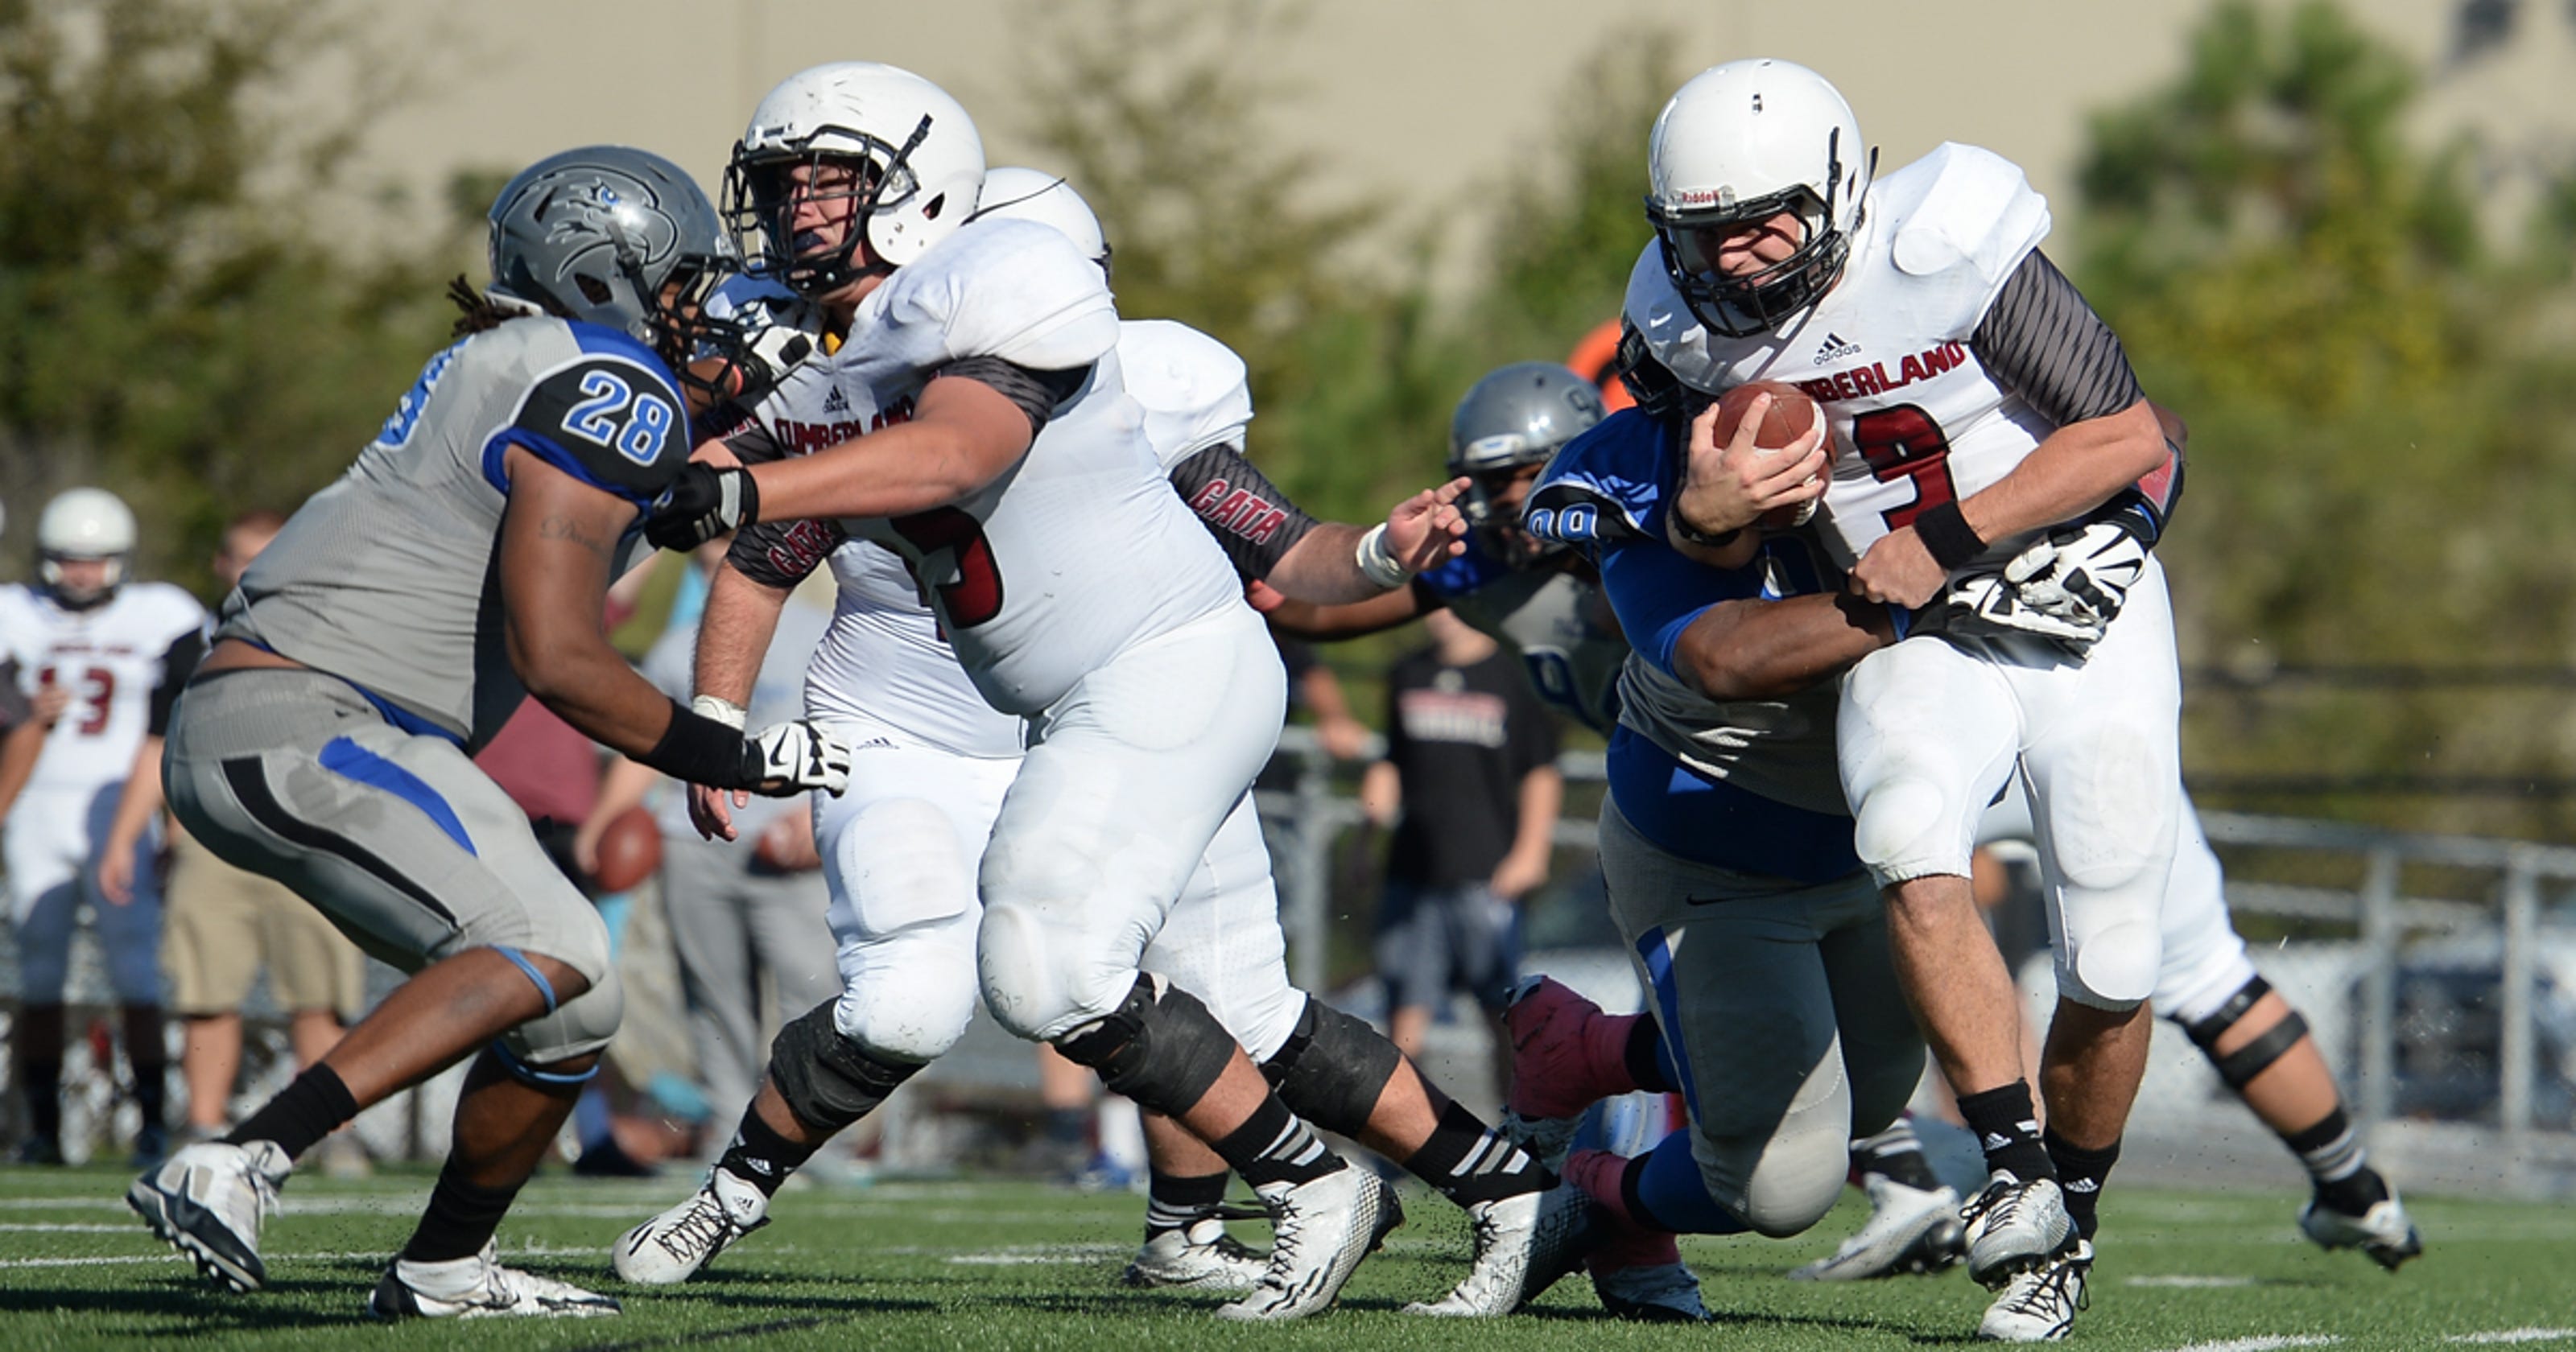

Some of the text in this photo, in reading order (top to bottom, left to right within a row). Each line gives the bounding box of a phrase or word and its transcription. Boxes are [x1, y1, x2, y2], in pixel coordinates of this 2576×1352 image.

[1797, 339, 1966, 403] BERLAND
[560, 369, 673, 468] 28
[1187, 478, 1288, 546] GATA
[39, 666, 116, 737] 3
